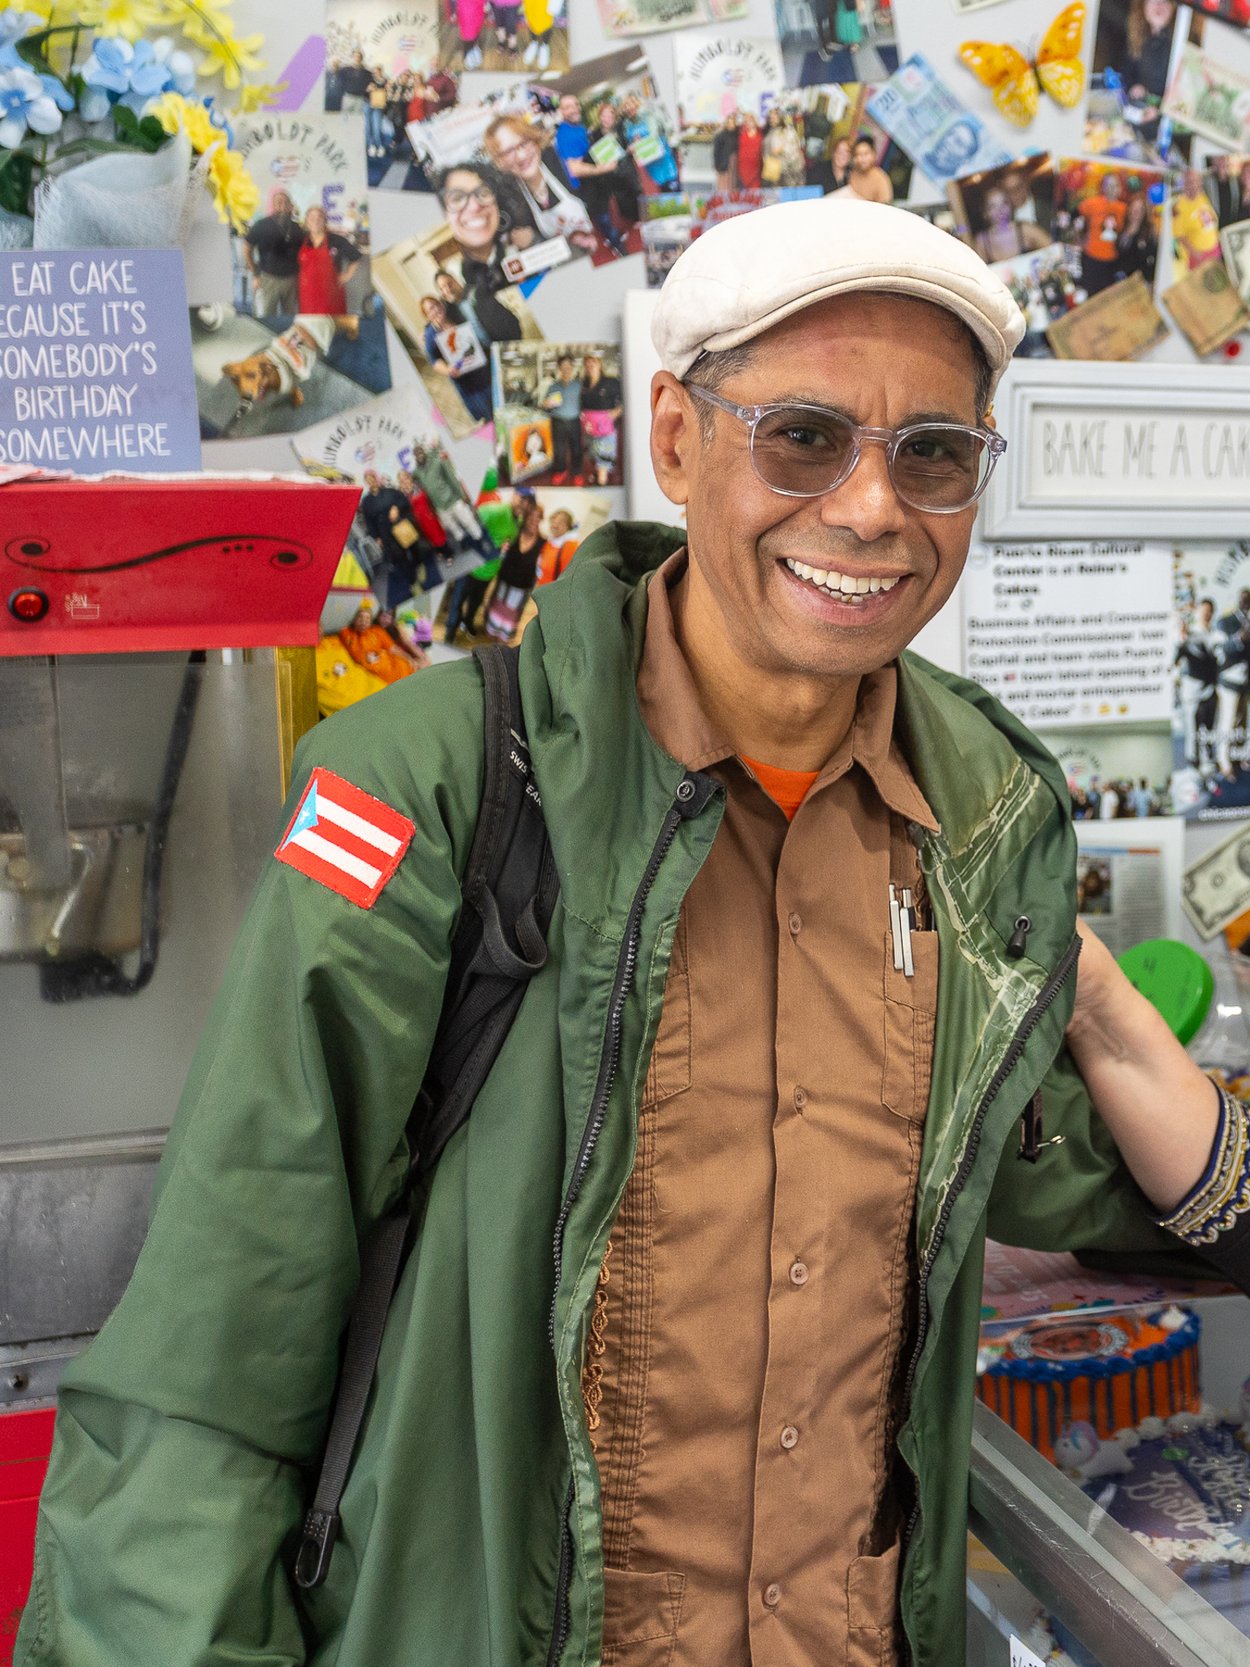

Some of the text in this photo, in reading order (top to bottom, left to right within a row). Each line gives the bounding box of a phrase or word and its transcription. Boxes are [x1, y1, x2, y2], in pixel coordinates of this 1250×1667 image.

[12, 259, 137, 297] EAT CAKE
[0, 300, 147, 339] ECAUSE IT'S
[14, 383, 139, 421] BIRTHDAY
[1042, 419, 1108, 480] BAKE
[1122, 420, 1161, 480] ME
[1169, 421, 1192, 480] A
[993, 564, 1043, 577] Center
[993, 584, 1039, 596] Cakes
[509, 750, 528, 774] SWIS
[525, 782, 542, 806] EAR
